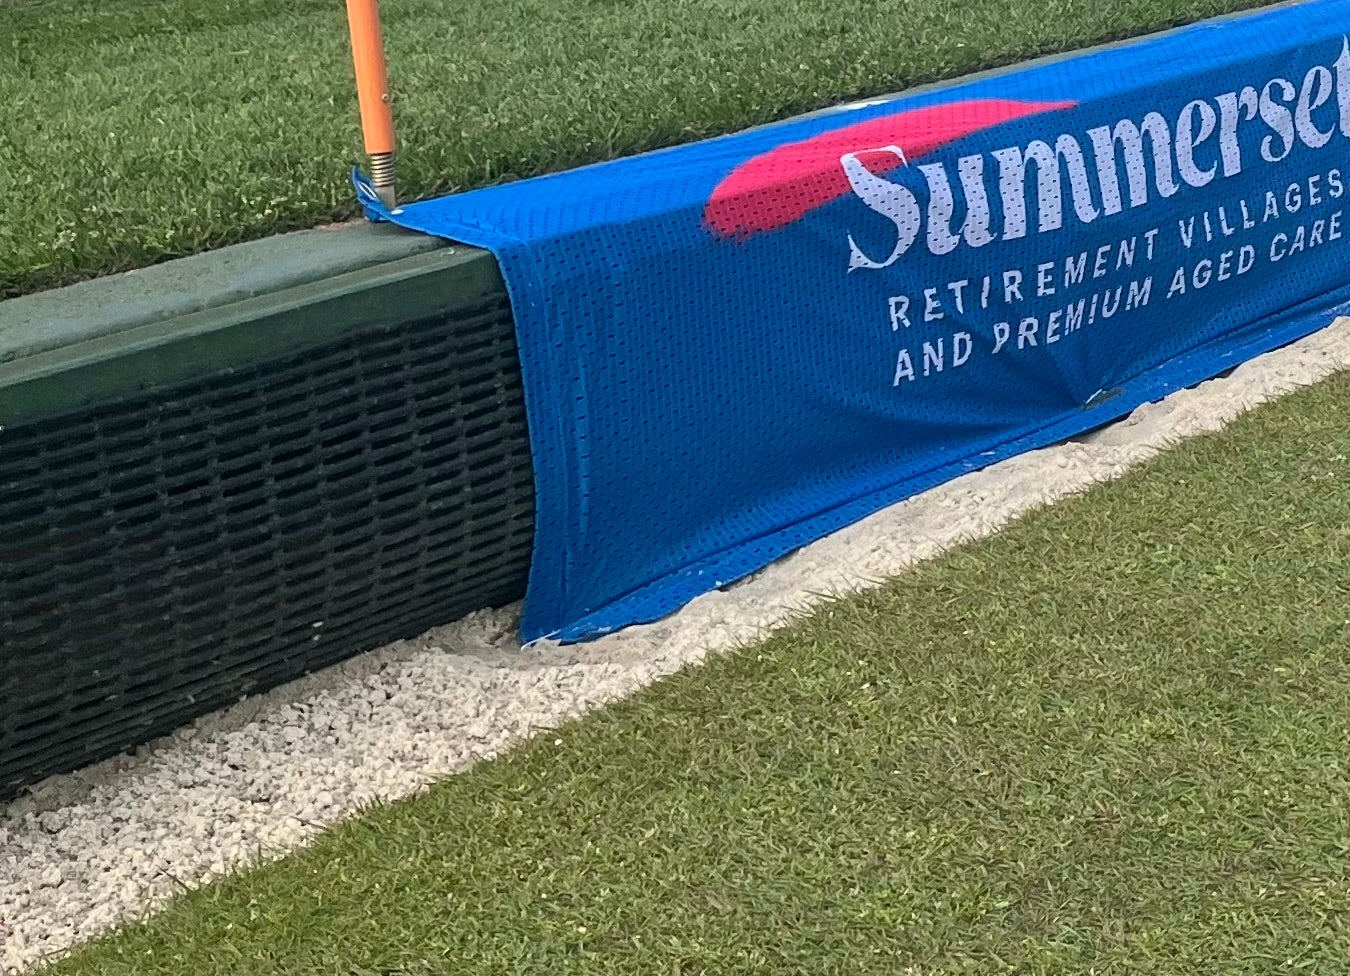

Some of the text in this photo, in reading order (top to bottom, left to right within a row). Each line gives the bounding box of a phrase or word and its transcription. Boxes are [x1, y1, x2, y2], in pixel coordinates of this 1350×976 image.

[889, 168, 1345, 331] RETIREMENT VILLAGES
[893, 211, 1344, 386] AND PREMIUM AGED CARE
